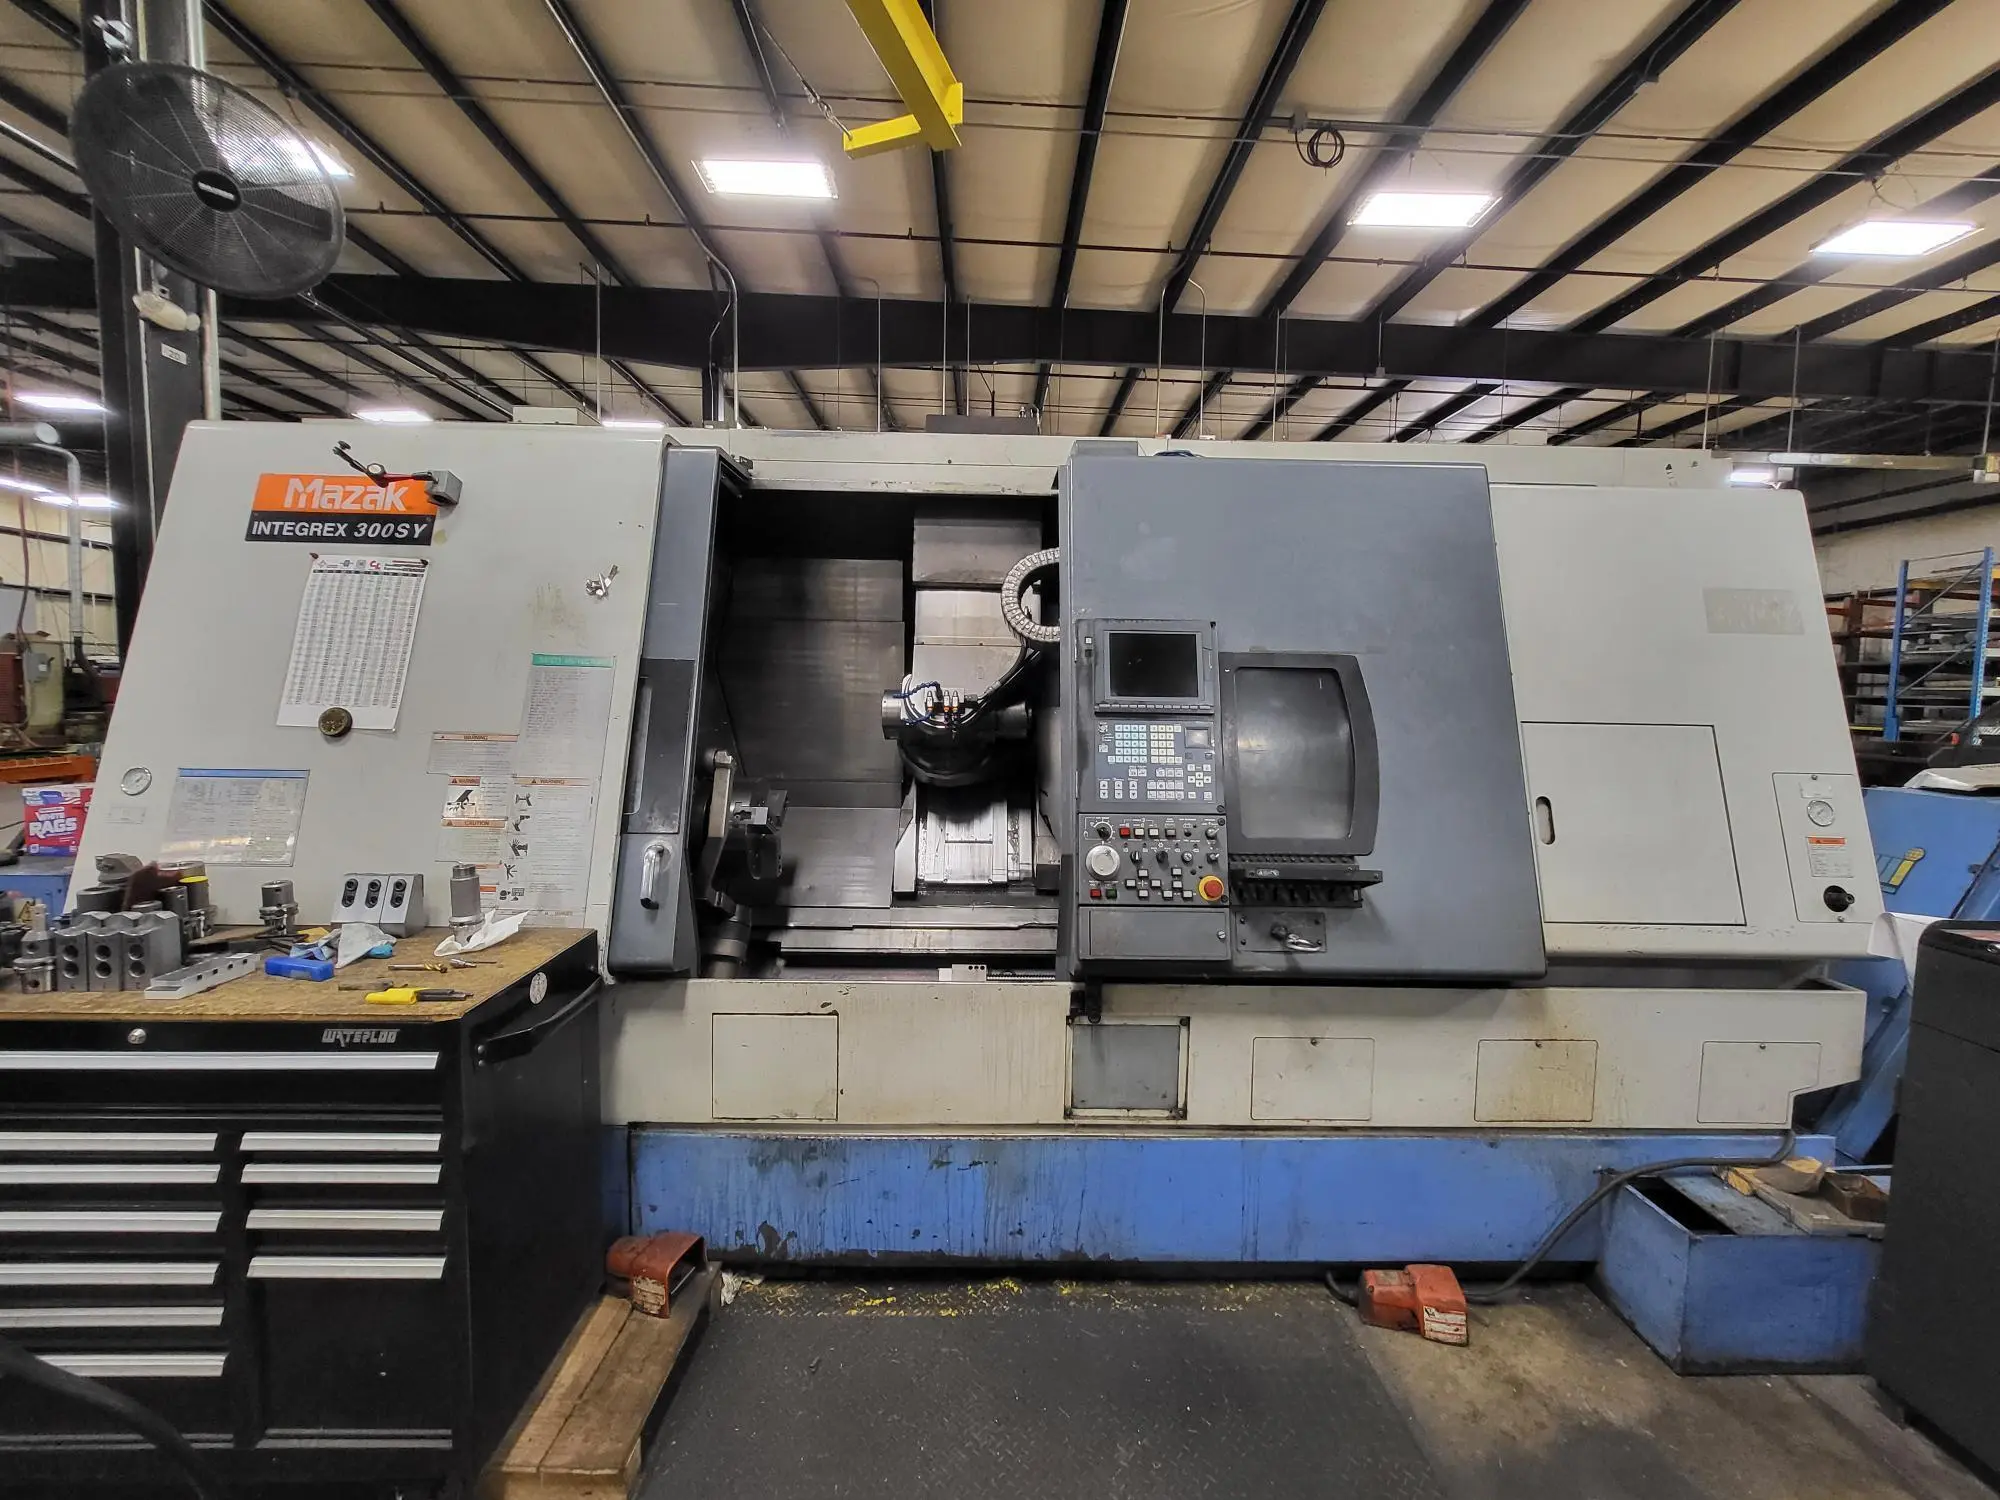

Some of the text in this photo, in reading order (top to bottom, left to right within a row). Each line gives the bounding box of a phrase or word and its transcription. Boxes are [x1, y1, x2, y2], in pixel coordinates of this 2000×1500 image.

[283, 478, 410, 512] Mazak
[251, 520, 428, 539] INTEGREX 300SY
[28, 816, 78, 839] RAGS
